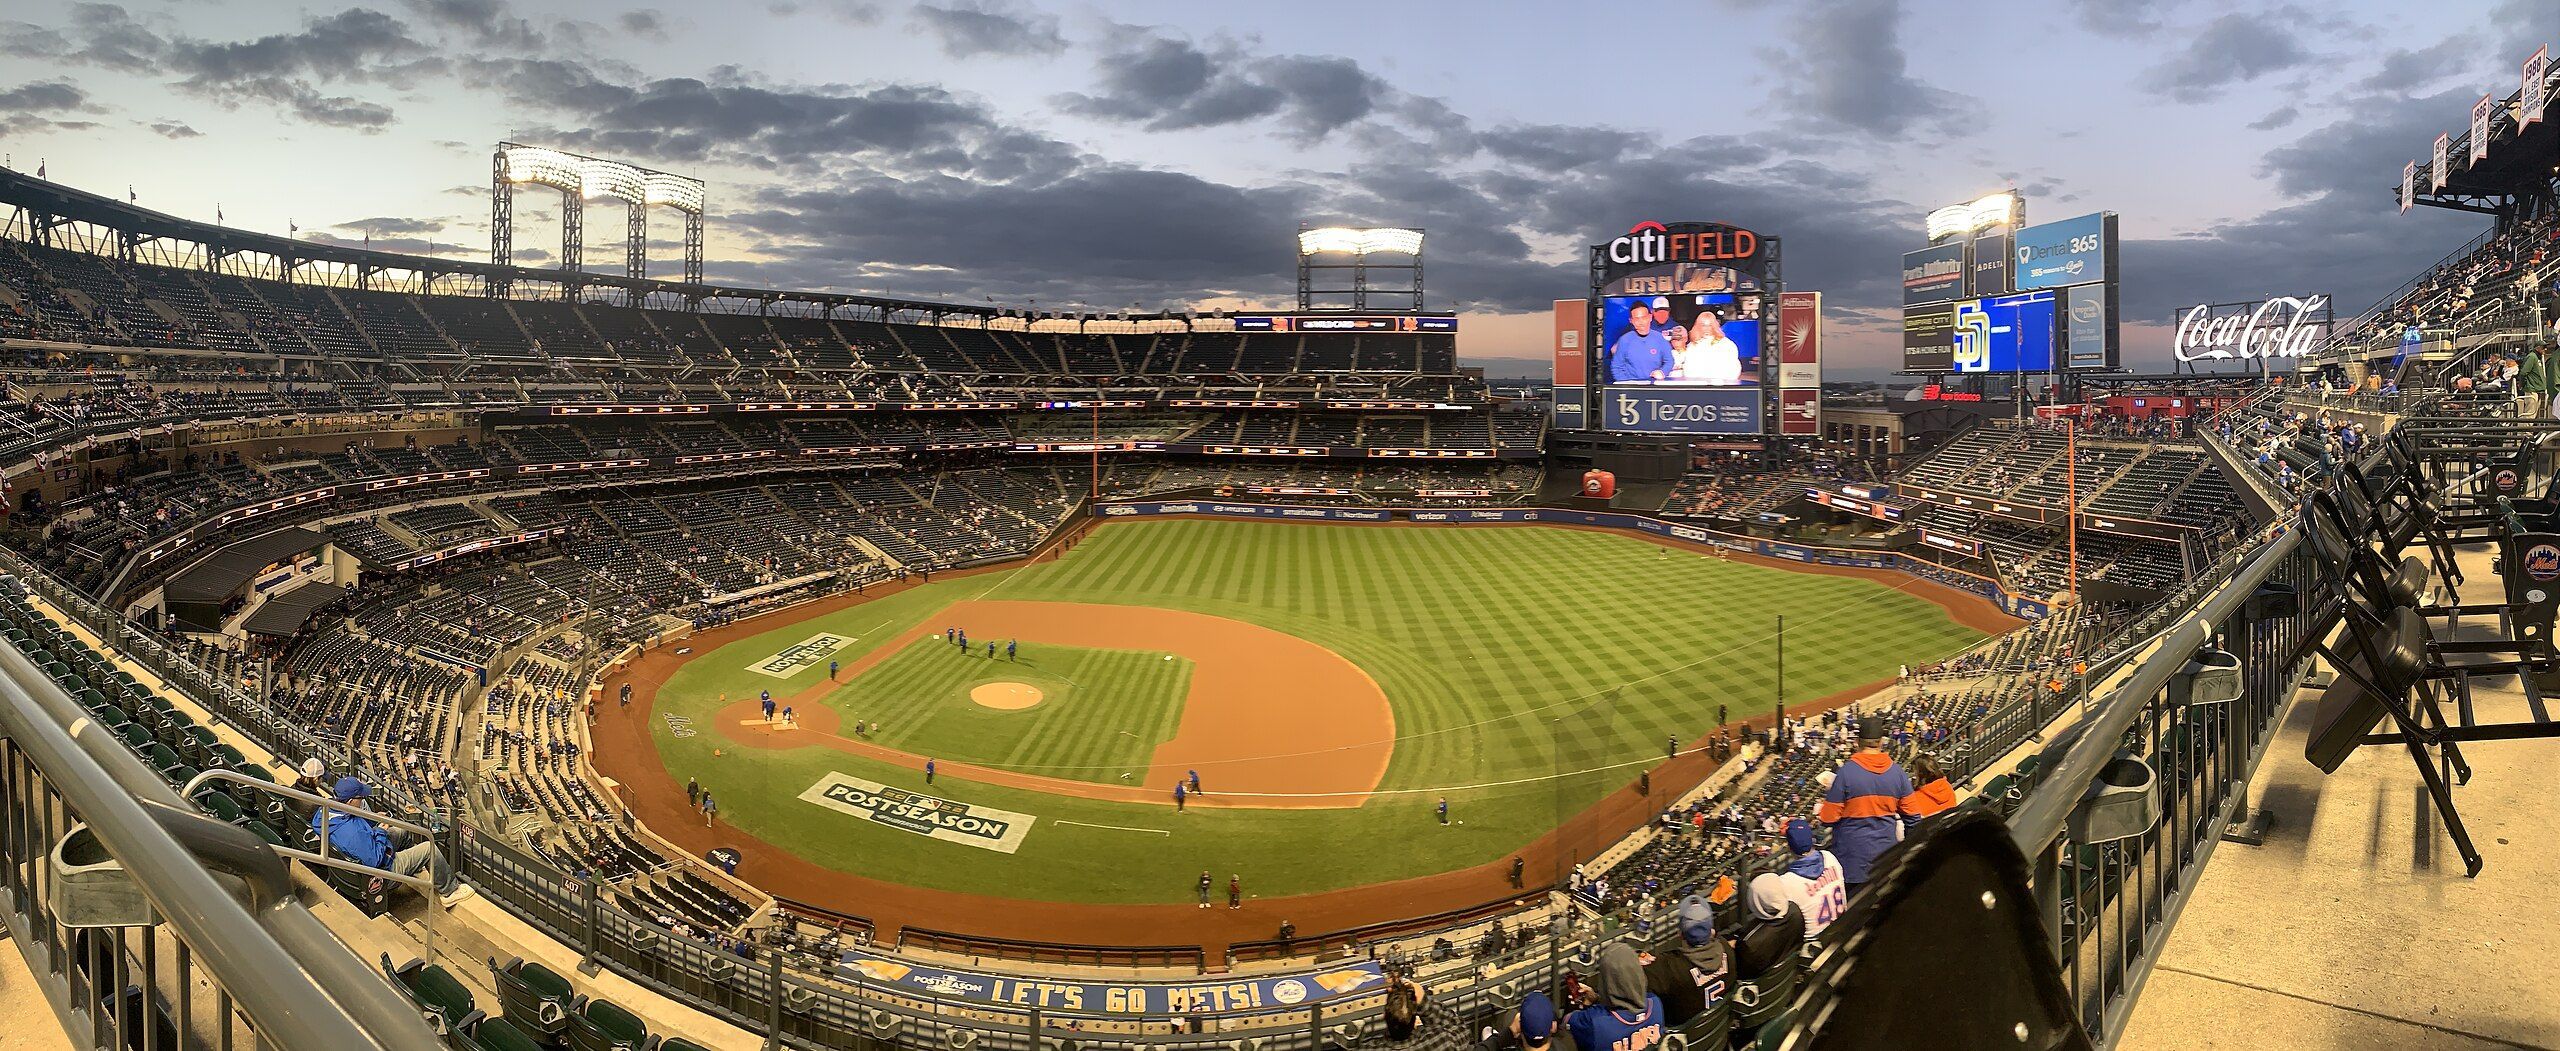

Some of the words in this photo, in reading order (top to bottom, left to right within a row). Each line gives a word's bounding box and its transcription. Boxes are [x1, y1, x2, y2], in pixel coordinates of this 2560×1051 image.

[1609, 228, 1666, 264] citi
[1669, 230, 1757, 261] FIELD
[1983, 260, 2004, 271] DELTA
[1933, 316, 1950, 324] CITY
[2174, 294, 2330, 362] Coca-Cola
[1645, 399, 1718, 422] Tezos
[1415, 512, 1447, 520] verizon
[830, 786, 1002, 837] POSTSEASON
[461, 826, 474, 836] 408
[564, 879, 579, 893] 407
[1817, 886, 1843, 924] 48
[913, 975, 983, 992] POSTSEASON
[991, 979, 1083, 1010] LET'S
[1105, 988, 1147, 1013] GO
[1168, 982, 1262, 1013] METS!
